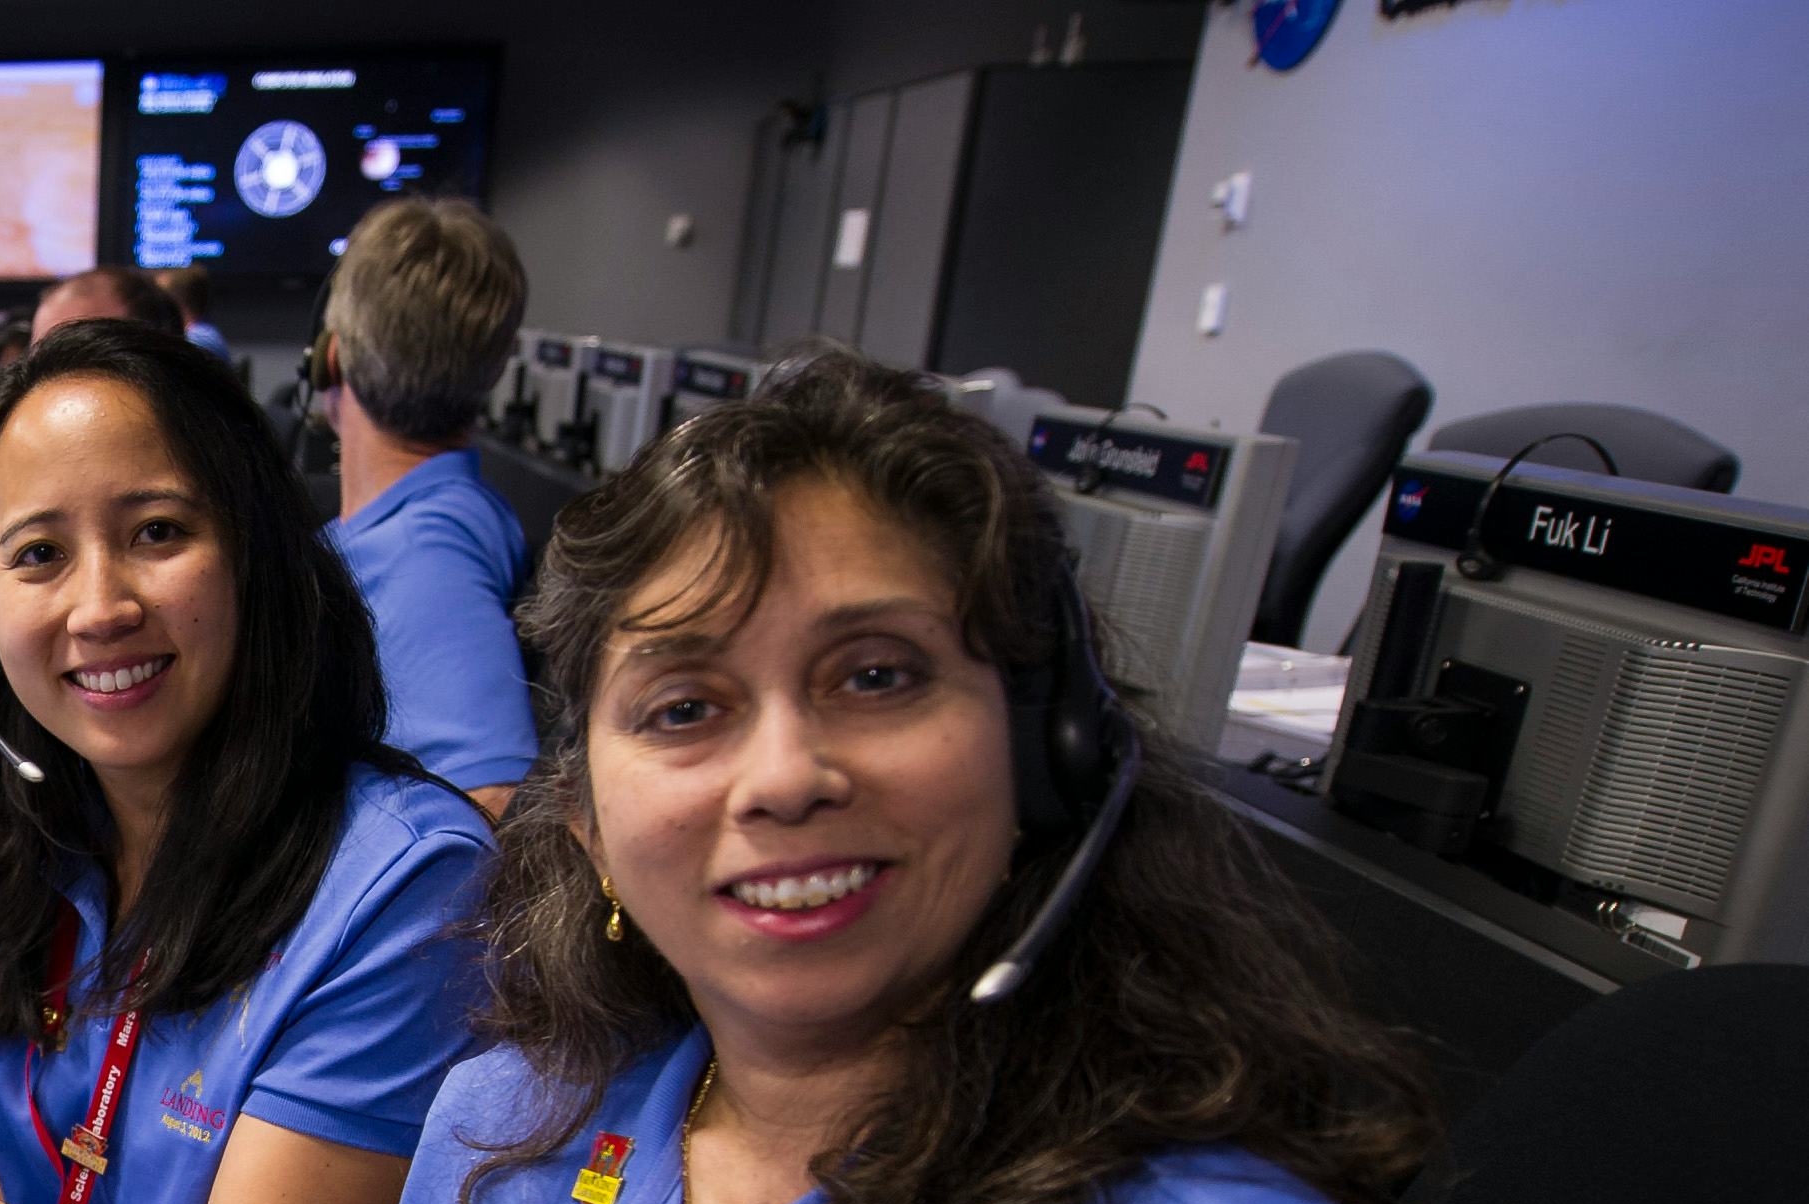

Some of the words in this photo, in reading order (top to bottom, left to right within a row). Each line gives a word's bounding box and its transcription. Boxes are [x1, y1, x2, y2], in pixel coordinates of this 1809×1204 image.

[1528, 505, 1580, 549] Fuk
[1582, 515, 1612, 556] Li
[1737, 544, 1791, 575] JPL
[116, 1010, 136, 1048] Mars
[92, 1064, 122, 1138] aboratory
[161, 1087, 225, 1130] LANDING
